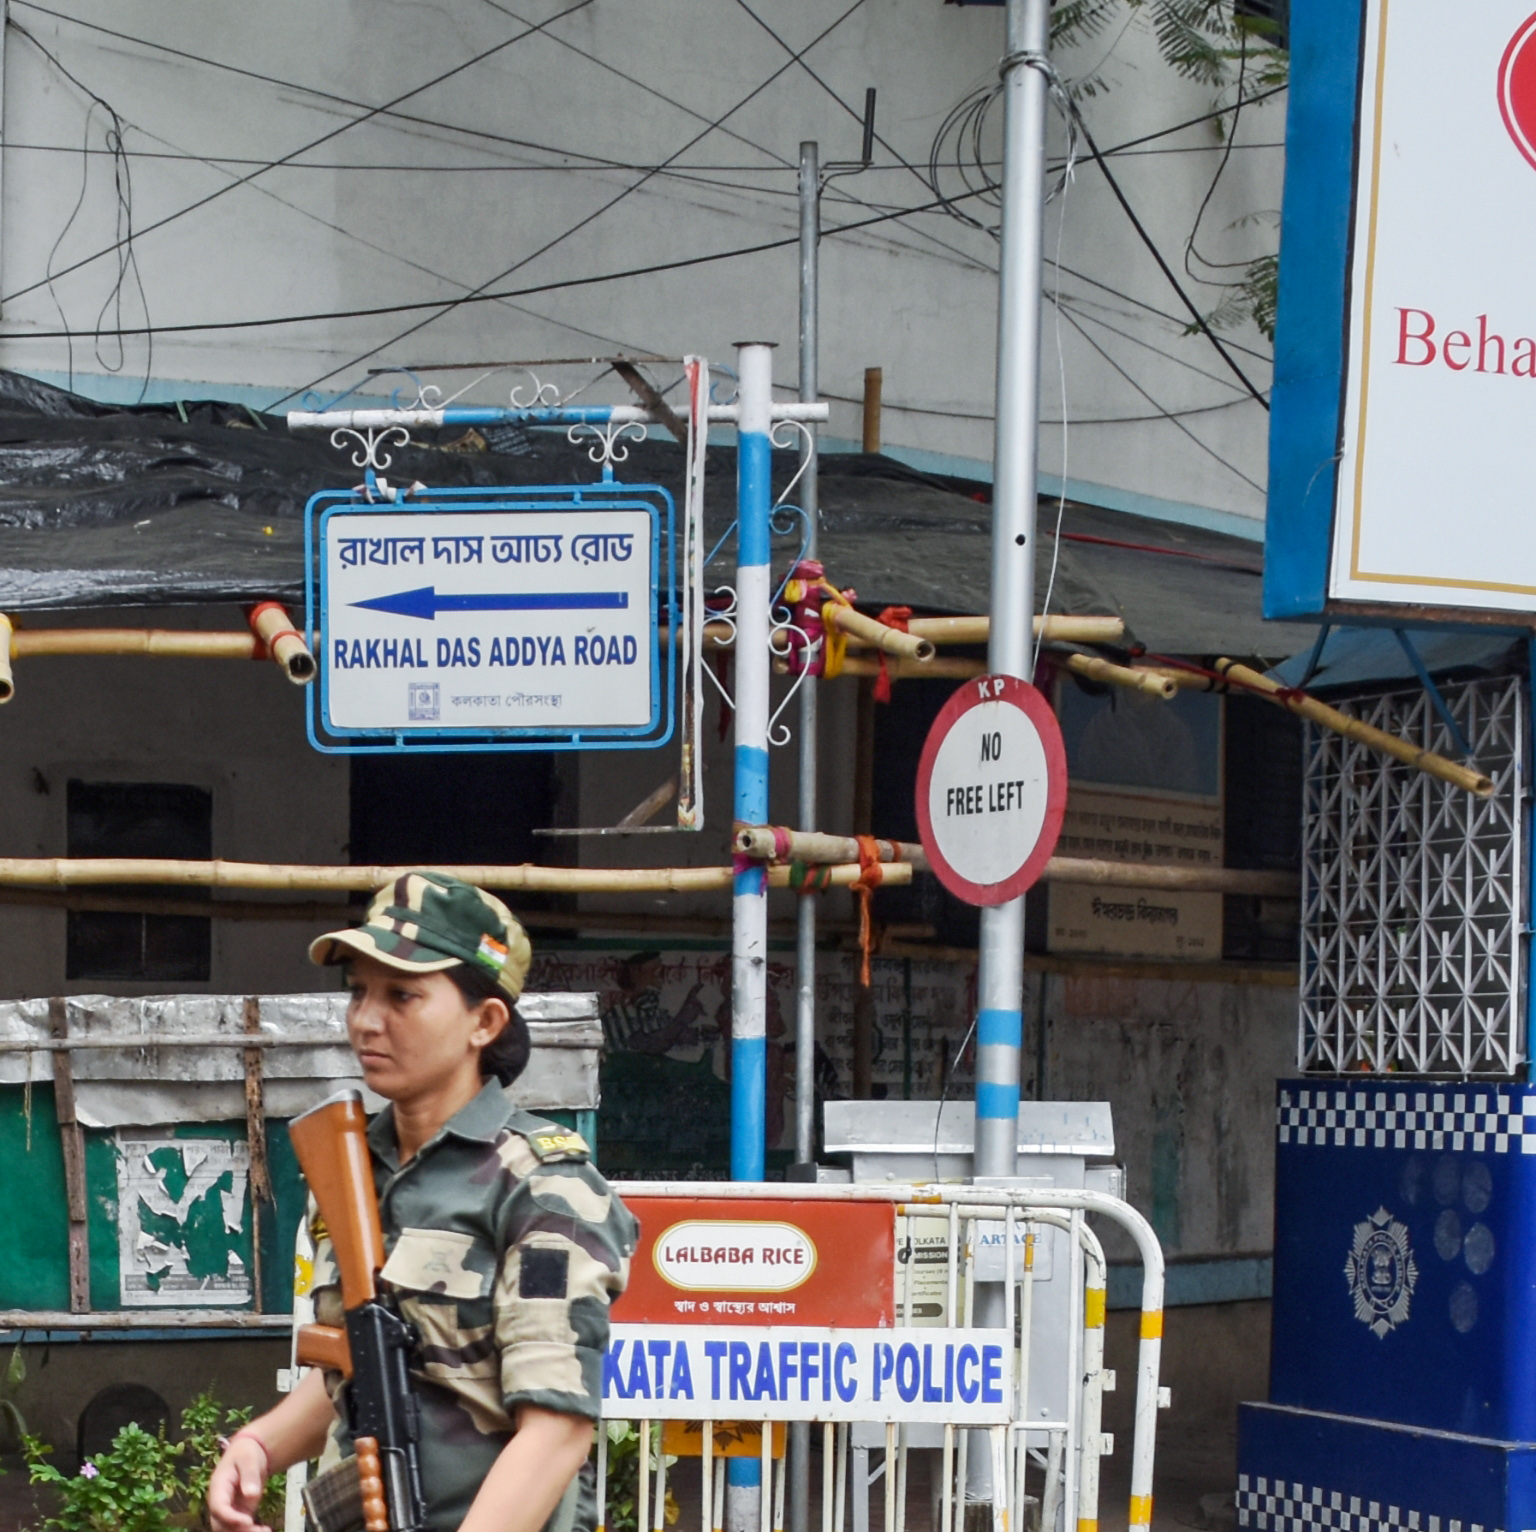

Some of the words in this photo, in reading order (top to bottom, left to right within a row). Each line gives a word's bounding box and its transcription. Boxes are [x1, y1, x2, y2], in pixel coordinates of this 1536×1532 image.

[337, 537, 426, 570] রাখাল
[432, 536, 485, 564] দাস
[490, 535, 564, 563] আঢ্য
[571, 534, 634, 565] রোড
[334, 638, 429, 669] RAKHAL
[436, 637, 481, 668] DAS
[488, 635, 567, 666] ADDYA
[574, 635, 638, 666] ROAD
[450, 693, 502, 708] কলকাতা
[505, 691, 563, 710] পৌরসংস্থা
[980, 731, 1002, 762] NO
[947, 785, 983, 817] FREE
[989, 780, 1024, 813] LEFT
[665, 1245, 754, 1264] LALBABA
[762, 1247, 804, 1264] RICE
[674, 1301, 695, 1314] স্বাদ
[699, 1303, 709, 1313] ও
[601, 1339, 695, 1400] KATA
[704, 1340, 858, 1403] TRAFFIC
[873, 1341, 1003, 1404] POLICE
